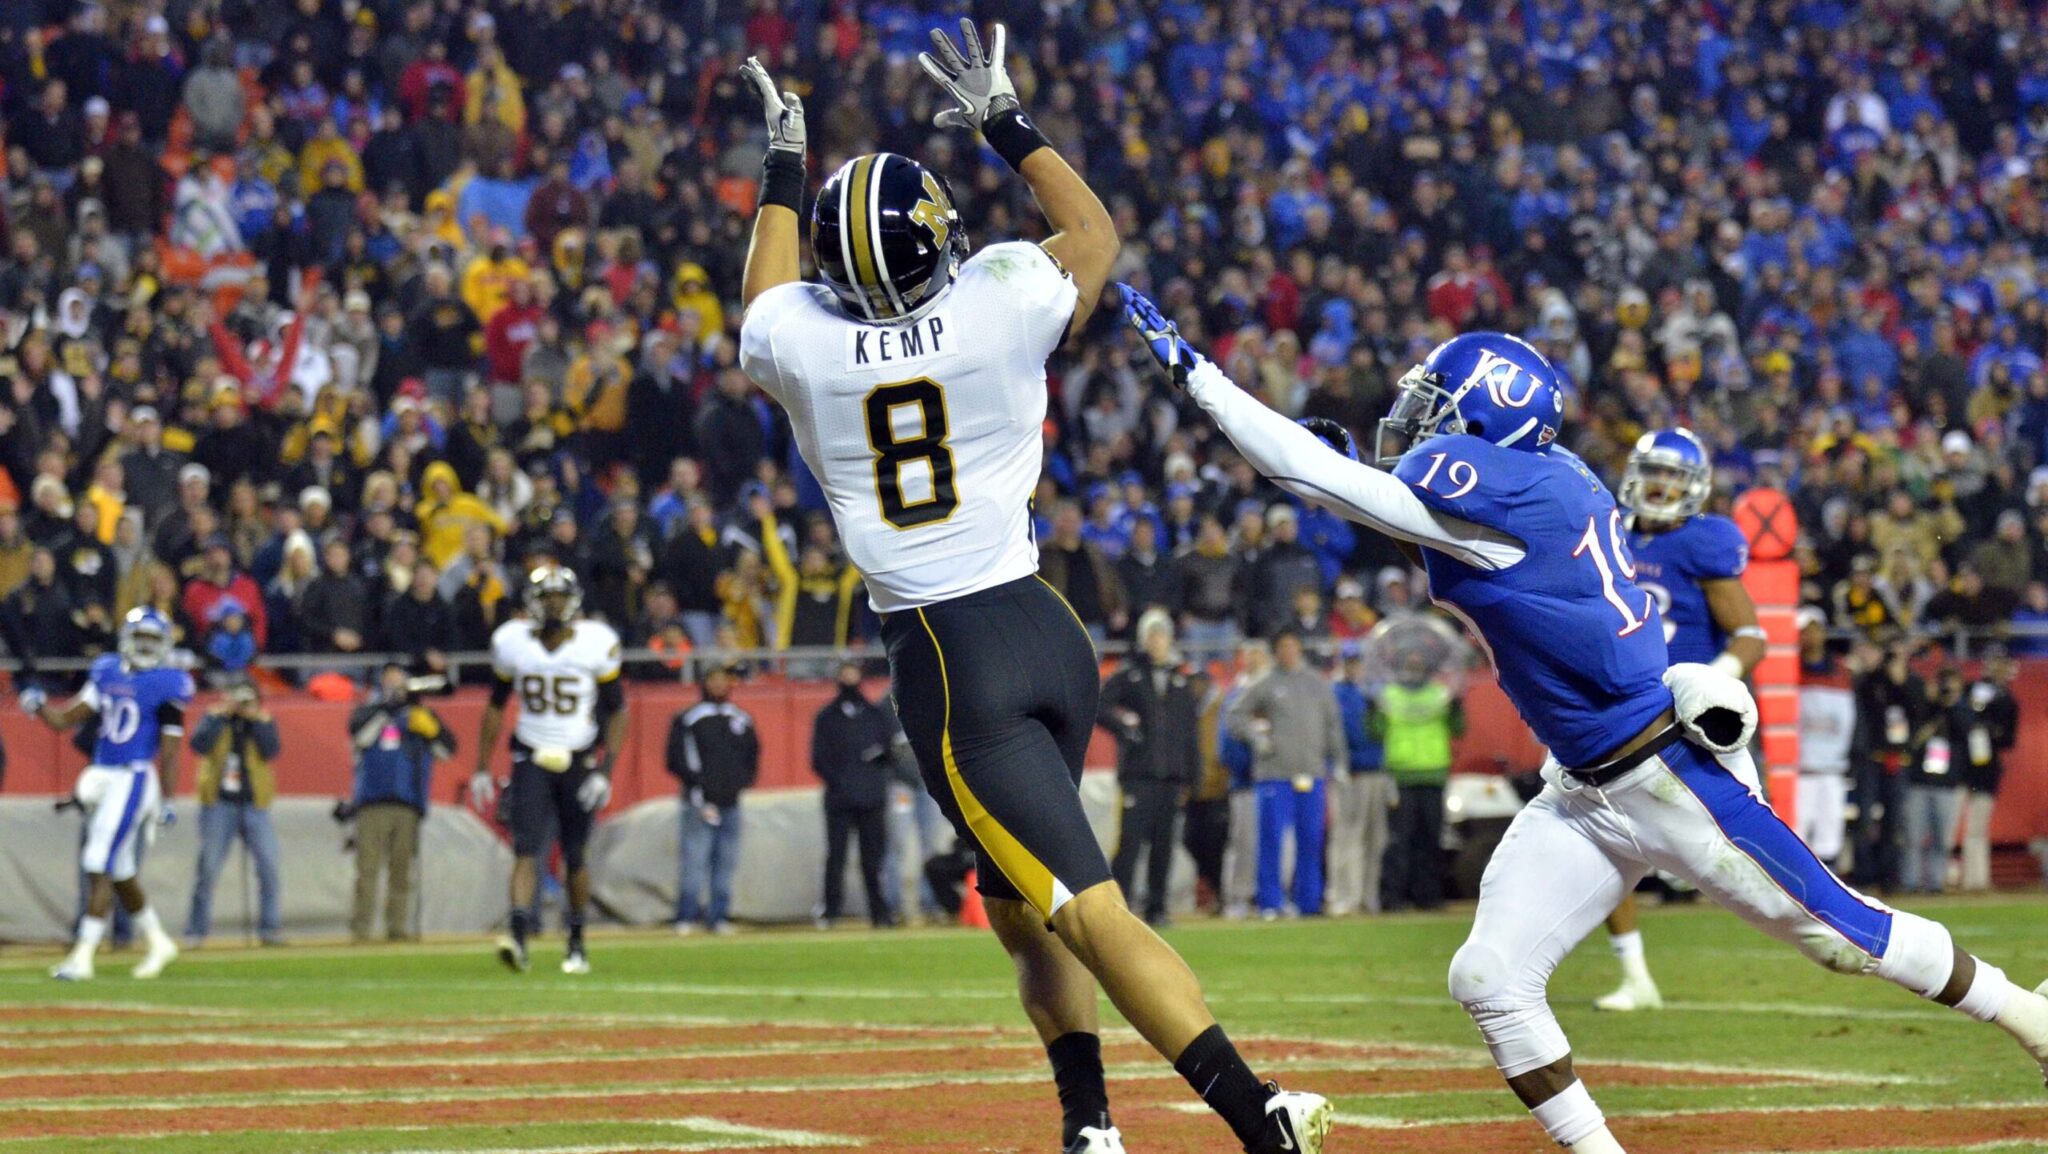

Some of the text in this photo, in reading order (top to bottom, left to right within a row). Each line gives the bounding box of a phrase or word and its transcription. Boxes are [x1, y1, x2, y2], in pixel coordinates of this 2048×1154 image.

[855, 316, 944, 365] KEMP
[1464, 347, 1544, 408] KU
[863, 375, 961, 532] 8
[1413, 452, 1479, 499] 19
[521, 673, 581, 716] 85
